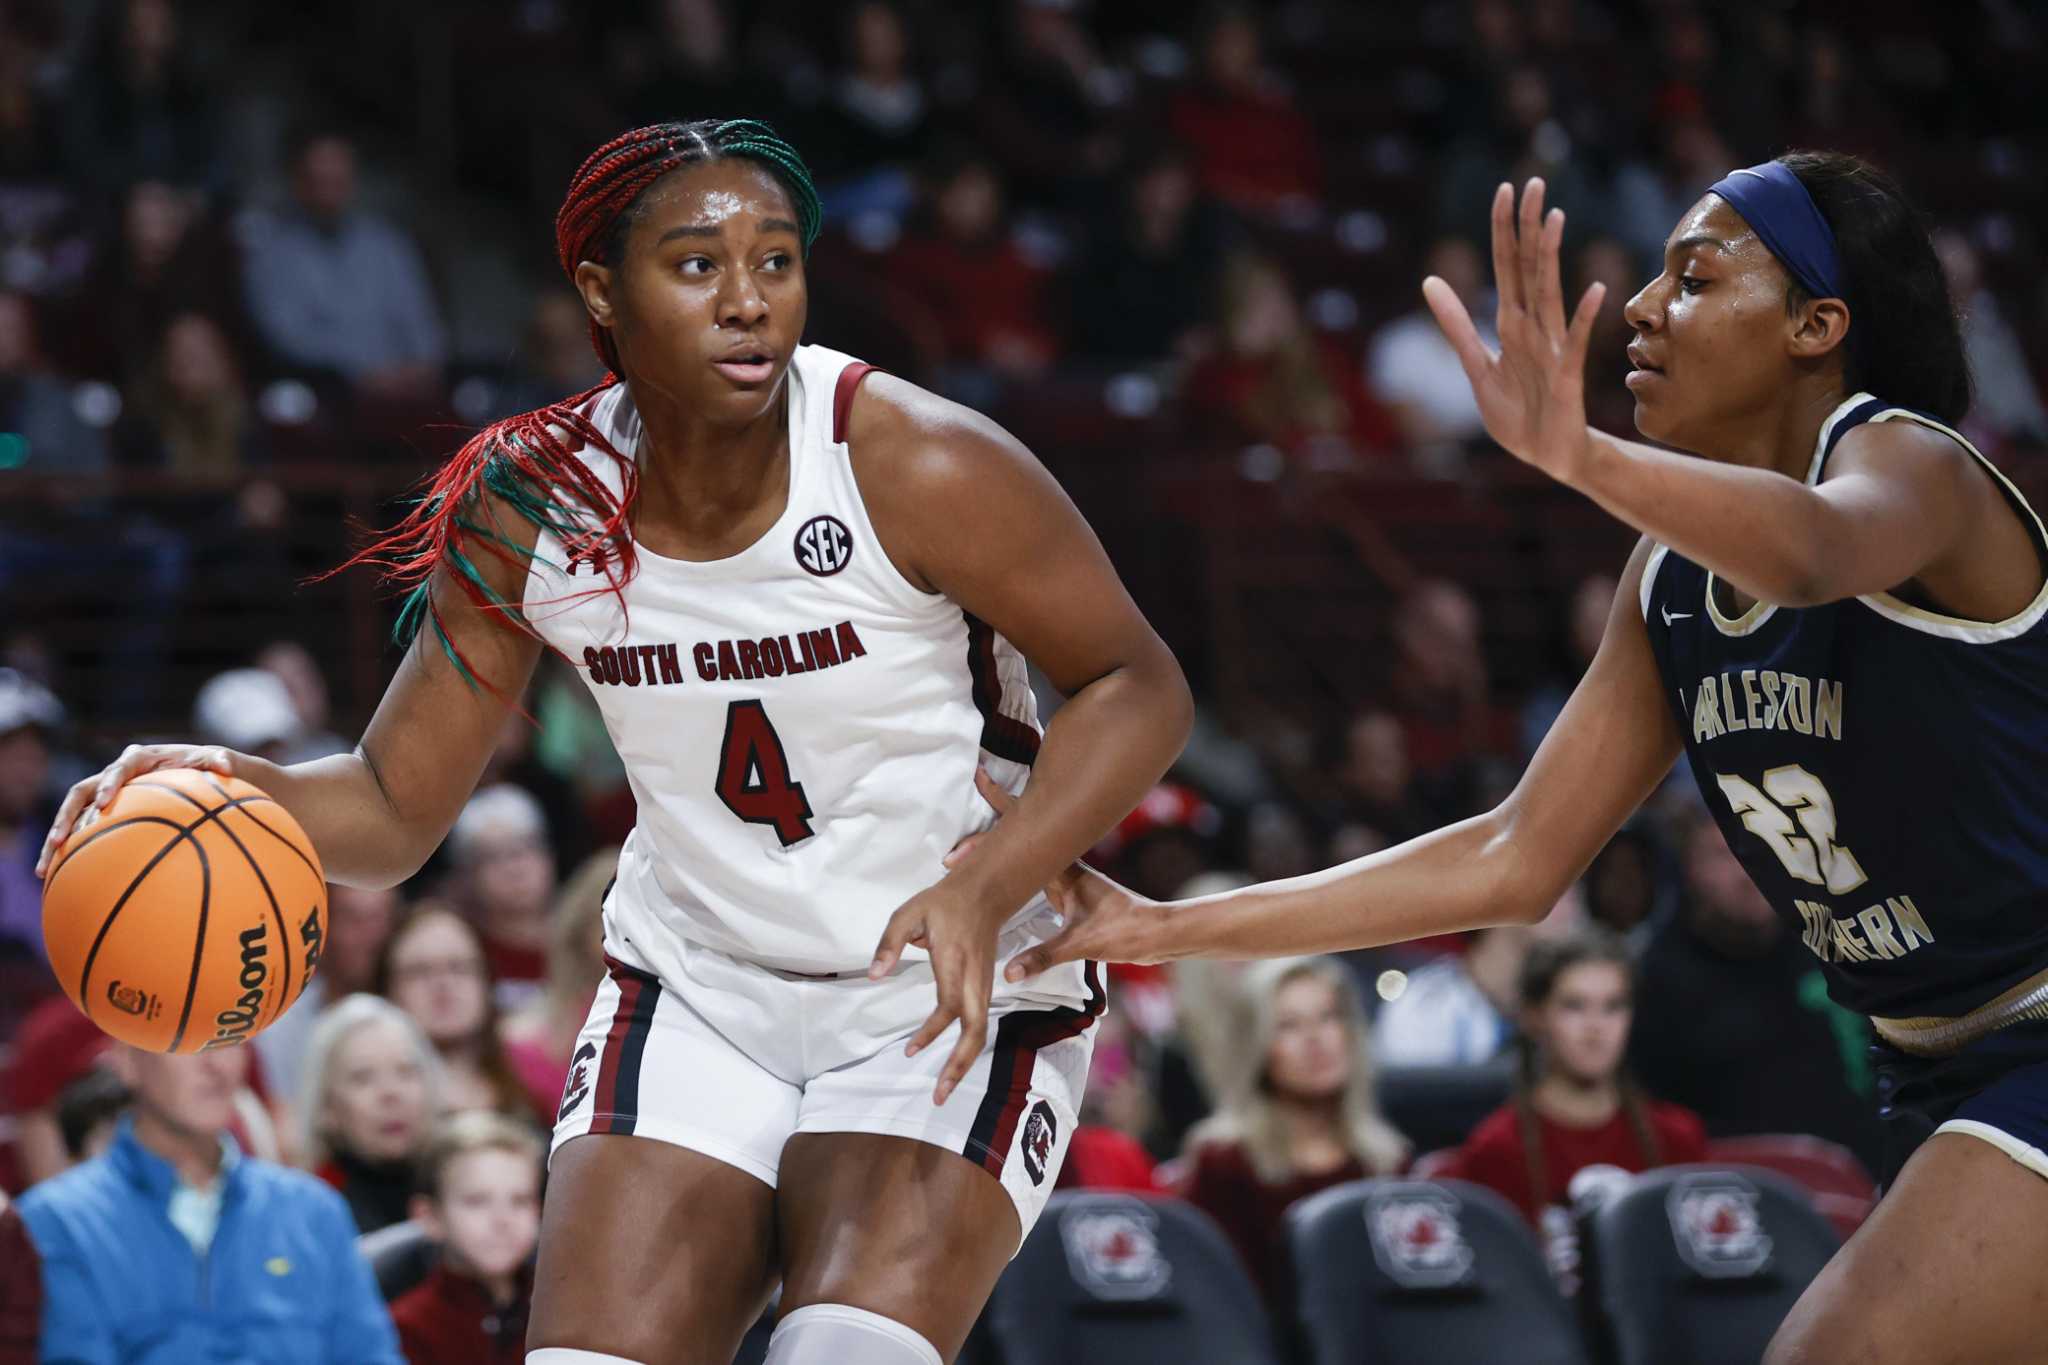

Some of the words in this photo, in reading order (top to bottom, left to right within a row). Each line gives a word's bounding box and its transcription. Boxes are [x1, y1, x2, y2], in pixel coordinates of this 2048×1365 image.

[796, 516, 852, 576] SEC
[583, 643, 684, 687] SOUTH
[693, 620, 868, 682] CAROLINA
[1679, 669, 1843, 744] ARLESTON
[715, 698, 815, 847] 4
[1716, 763, 1869, 895] 22
